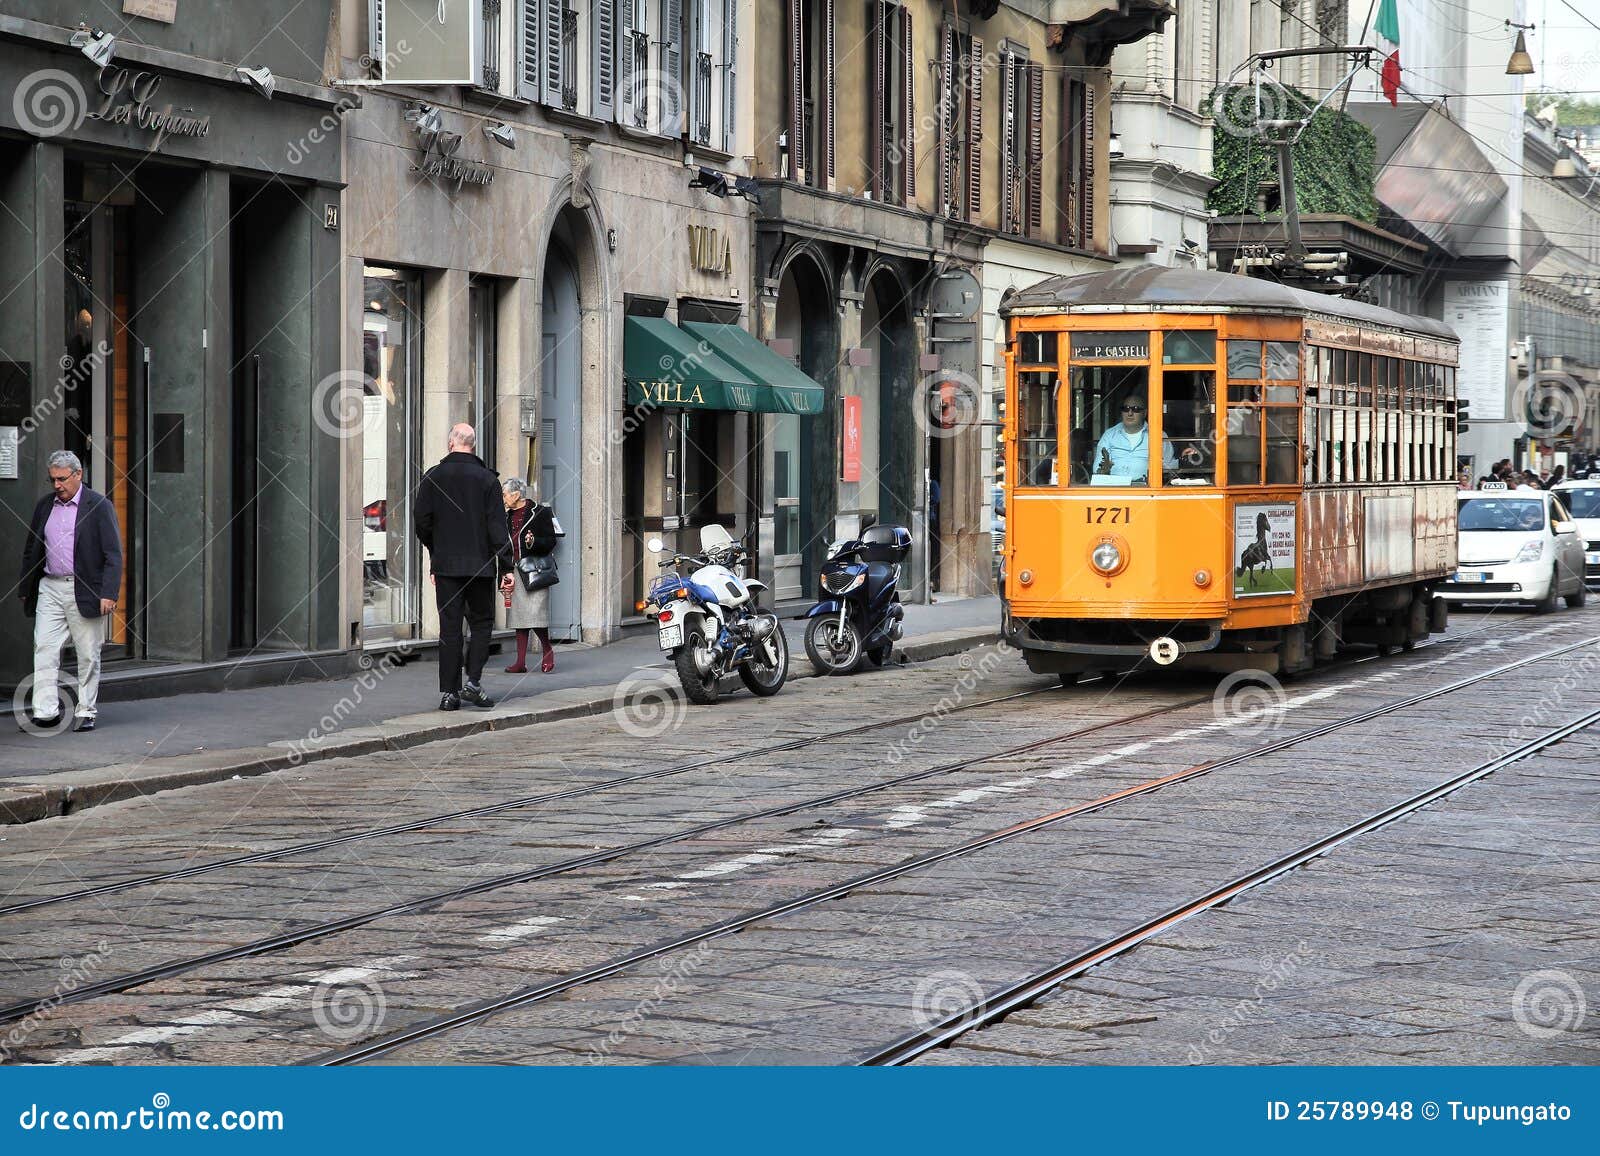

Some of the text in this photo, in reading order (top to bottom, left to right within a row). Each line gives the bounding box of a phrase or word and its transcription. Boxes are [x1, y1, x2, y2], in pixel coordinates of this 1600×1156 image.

[87, 64, 132, 124] Les
[327, 207, 337, 227] 21
[687, 224, 732, 279] VILLA
[639, 381, 705, 404] VILLA
[731, 386, 752, 407] VILLA
[791, 392, 810, 411] VILLA
[1086, 506, 1130, 524] 1771
